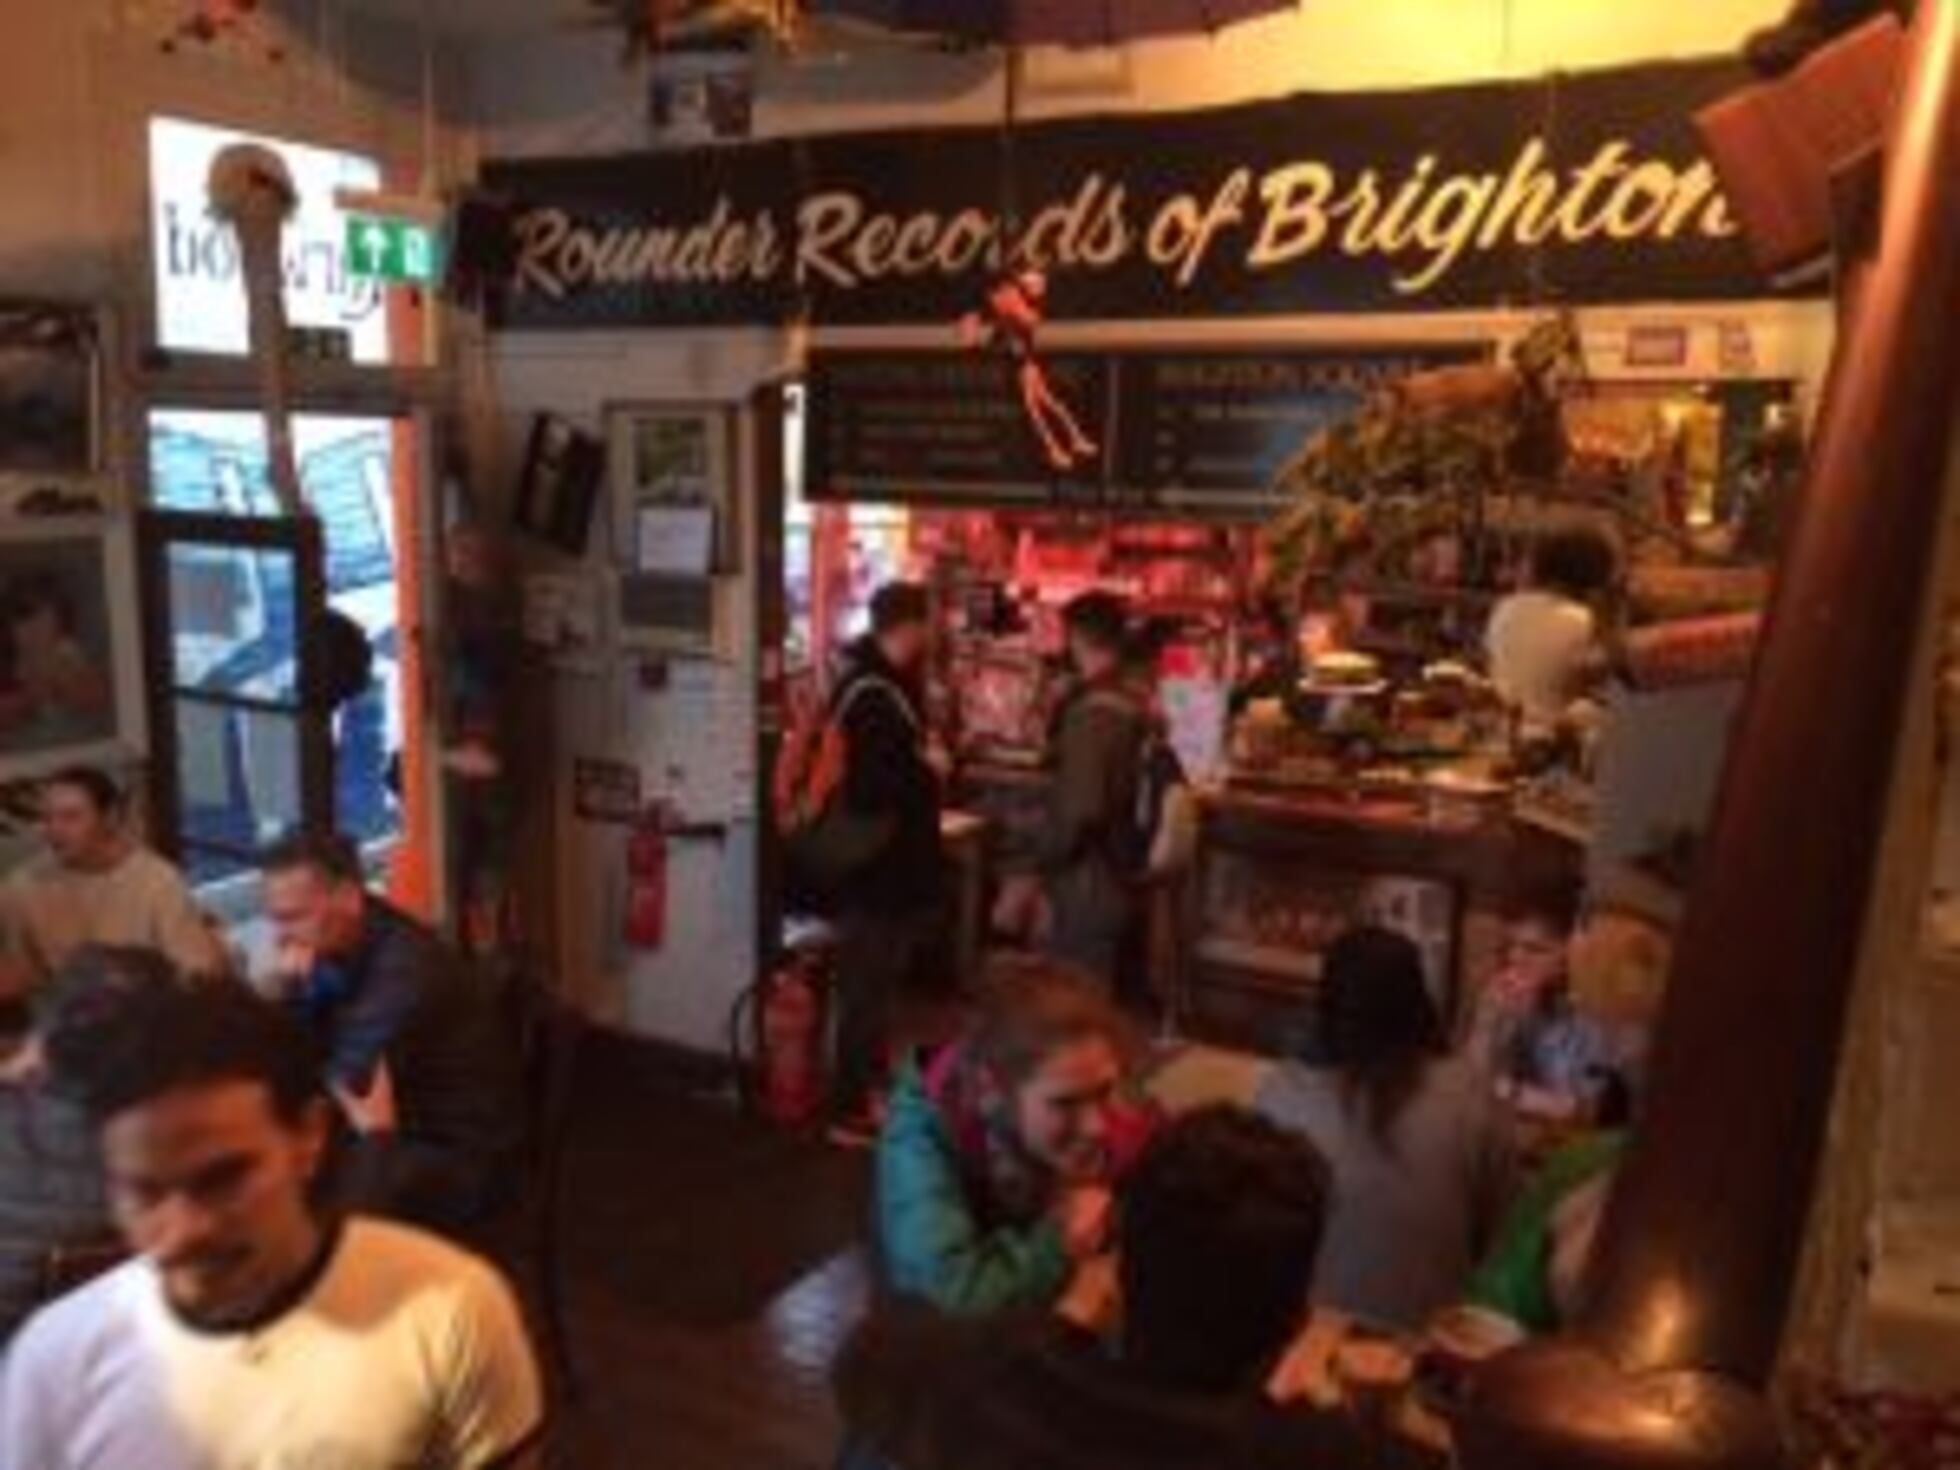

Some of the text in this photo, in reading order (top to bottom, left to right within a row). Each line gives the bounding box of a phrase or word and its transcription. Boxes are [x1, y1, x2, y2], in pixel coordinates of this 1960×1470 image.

[515, 197, 779, 295] Rounder
[1147, 167, 1249, 286] of
[1247, 138, 1735, 292] Brighton
